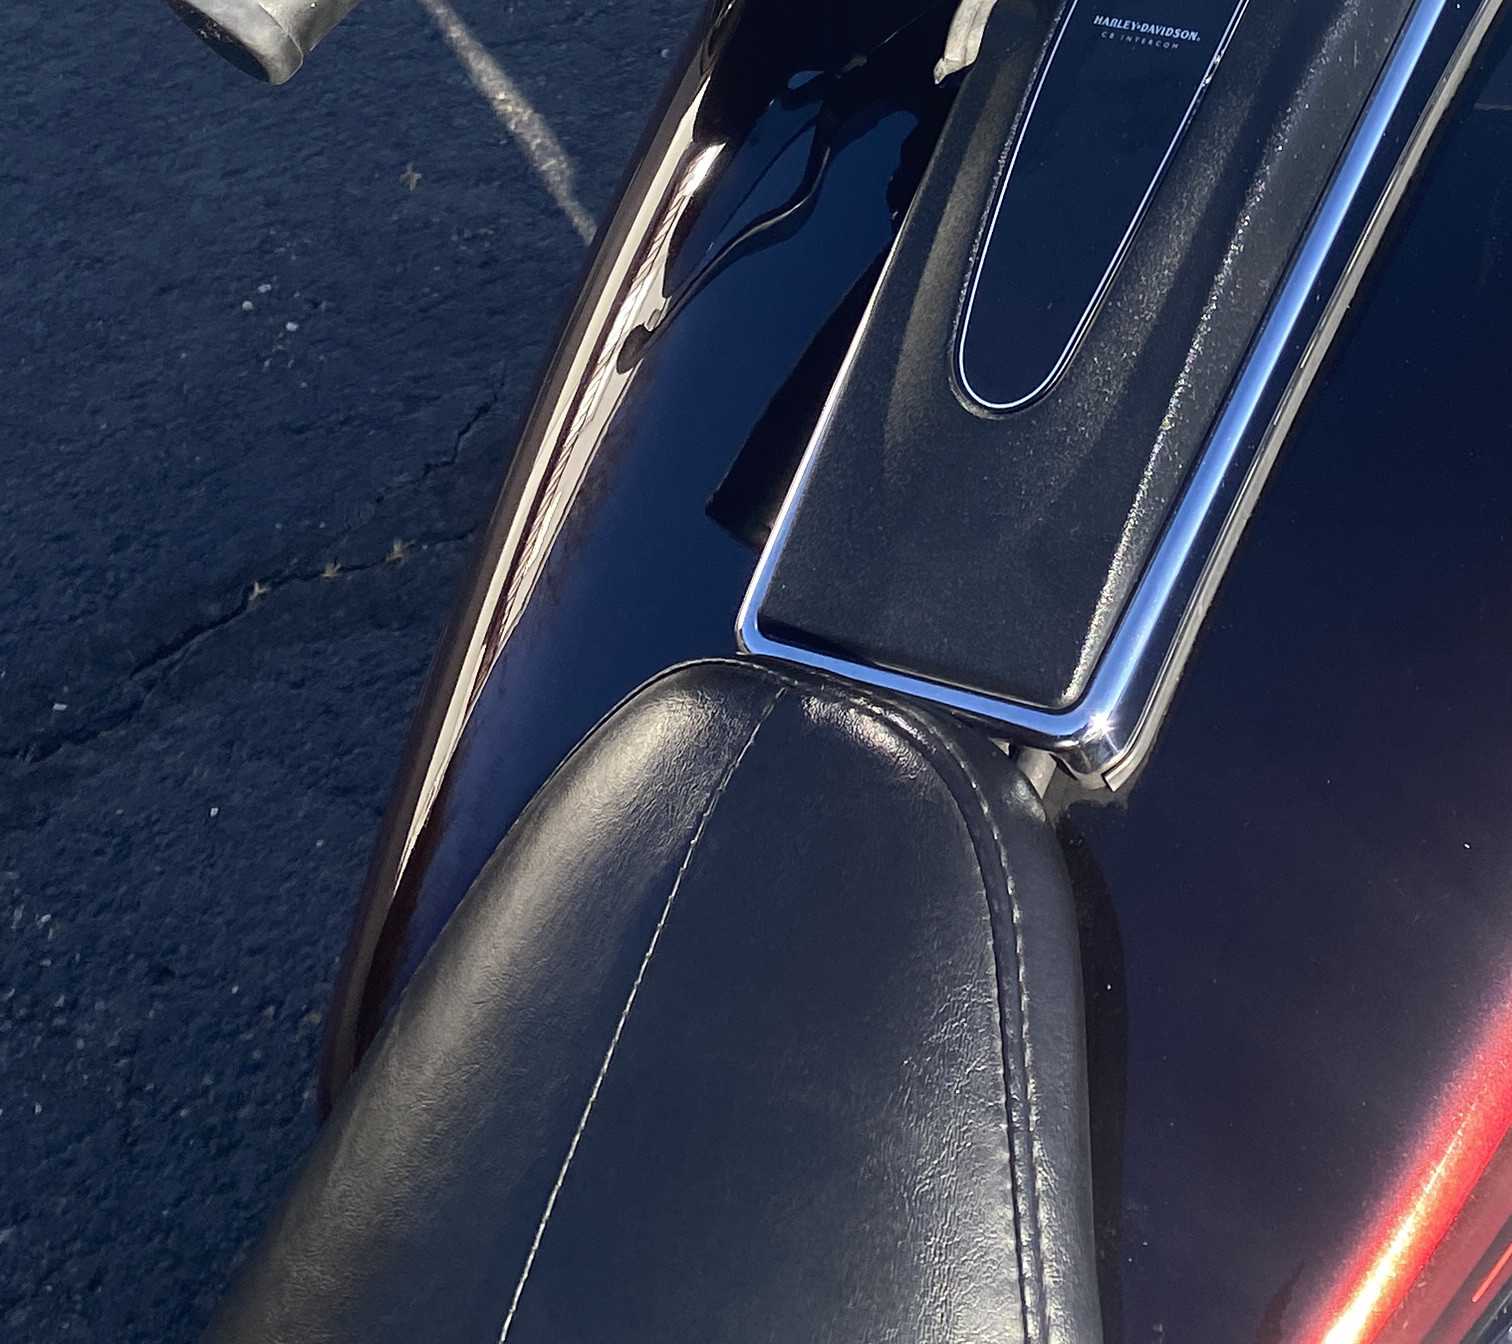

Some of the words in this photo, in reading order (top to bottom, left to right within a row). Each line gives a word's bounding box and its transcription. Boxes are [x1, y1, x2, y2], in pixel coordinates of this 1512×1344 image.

[1093, 15, 1199, 42] HARLEY-DAVIDSON
[1101, 31, 1115, 40] CB
[1120, 34, 1179, 49] INTERCOM
